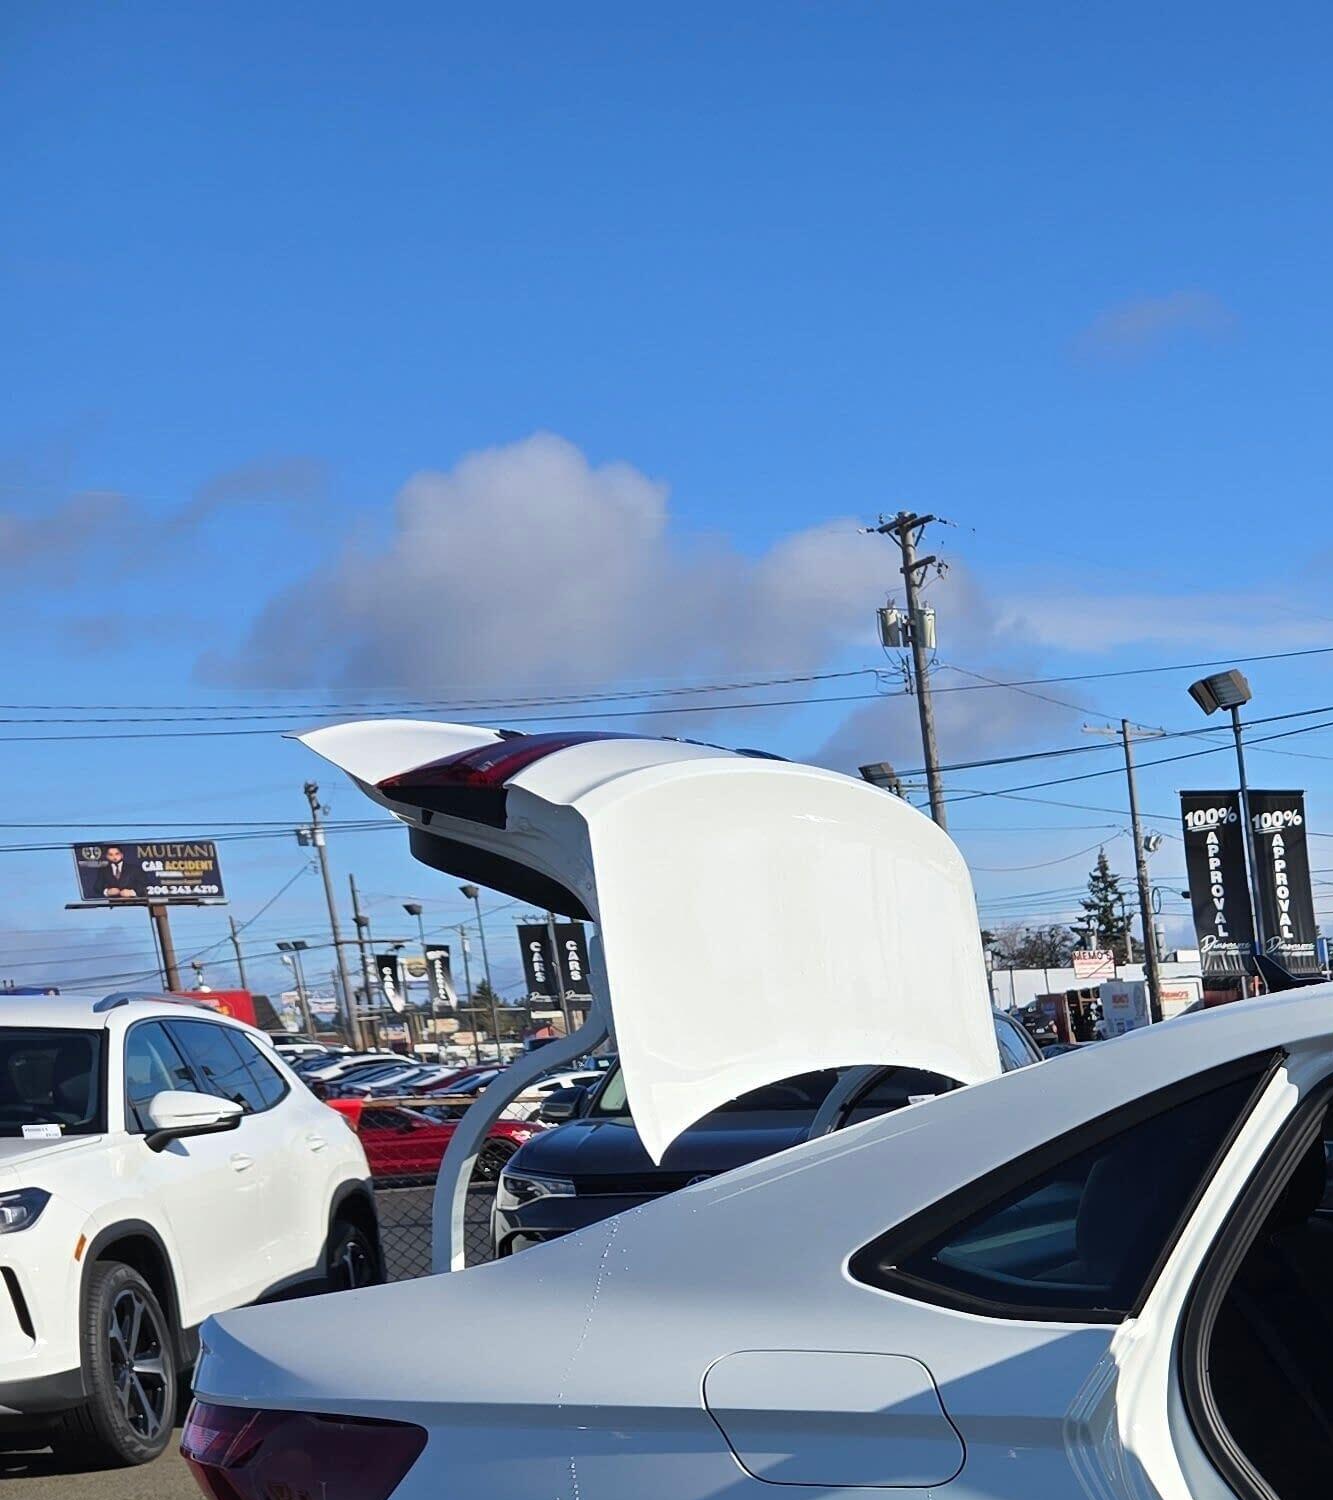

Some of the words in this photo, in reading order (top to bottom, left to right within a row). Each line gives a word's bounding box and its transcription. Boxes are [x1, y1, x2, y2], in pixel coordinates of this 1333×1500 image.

[1185, 806, 1237, 828] 100%
[1252, 809, 1302, 829] 100%
[137, 844, 214, 858] MULTANI
[141, 860, 164, 872] CAR
[165, 860, 213, 871] ACCIDENT
[1206, 831, 1229, 937] APPROVAL
[1271, 833, 1294, 939] APPROVAL
[529, 941, 546, 983] CARS
[565, 940, 582, 981] CARS
